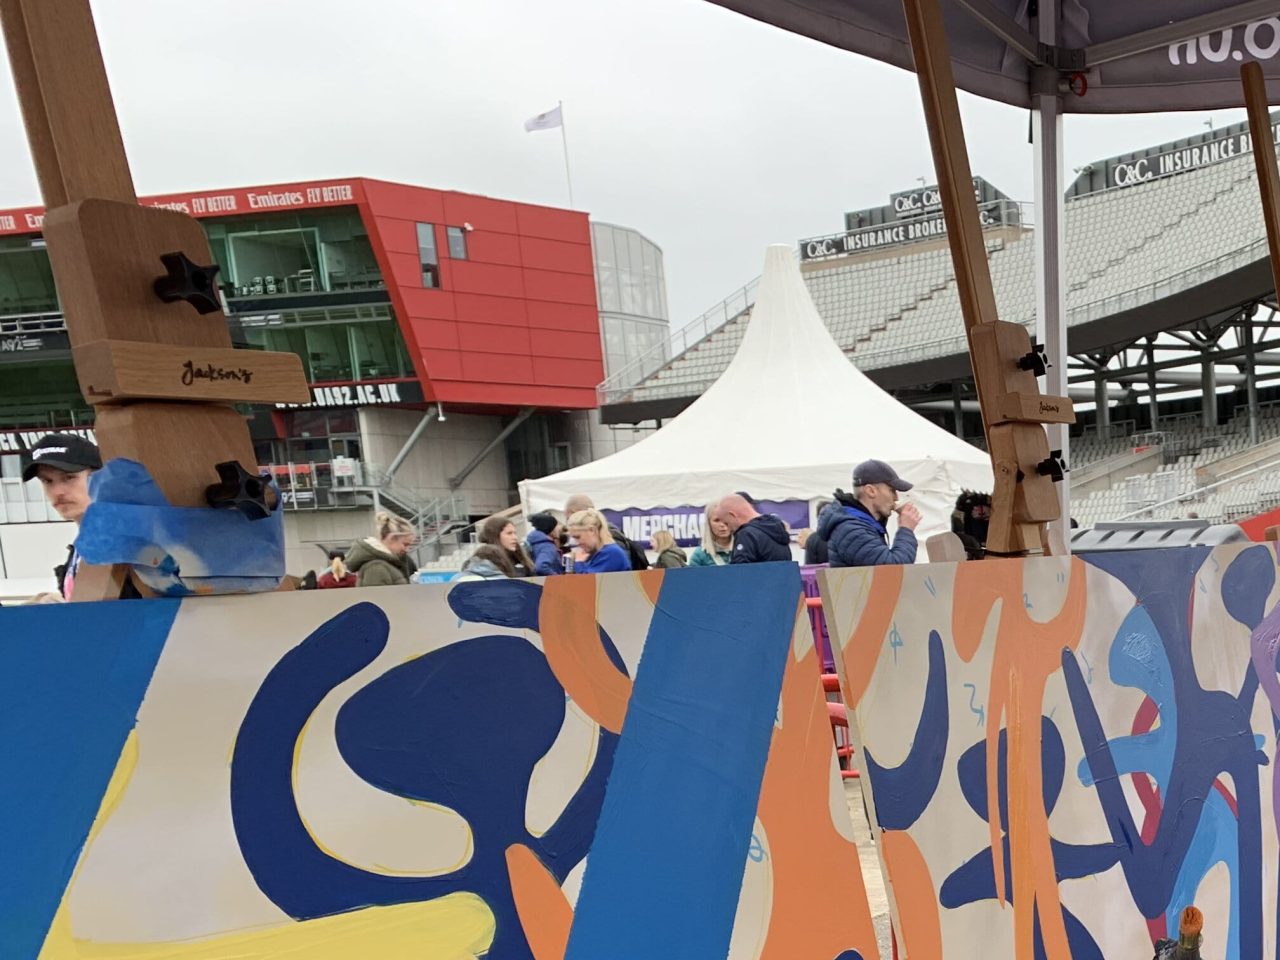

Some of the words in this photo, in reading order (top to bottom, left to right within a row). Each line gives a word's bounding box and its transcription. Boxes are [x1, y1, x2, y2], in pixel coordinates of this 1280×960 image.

[1160, 139, 1235, 174] INSURANCE
[192, 198, 205, 213] FLY
[207, 195, 237, 212] BETTER
[247, 191, 304, 209] Emirates
[306, 187, 321, 204] FLY
[322, 185, 353, 201] BETTER
[843, 226, 904, 251] INSURANCE
[908, 216, 948, 240] BROKE
[182, 360, 253, 386] Jackson's
[622, 512, 706, 543] MERCHA
